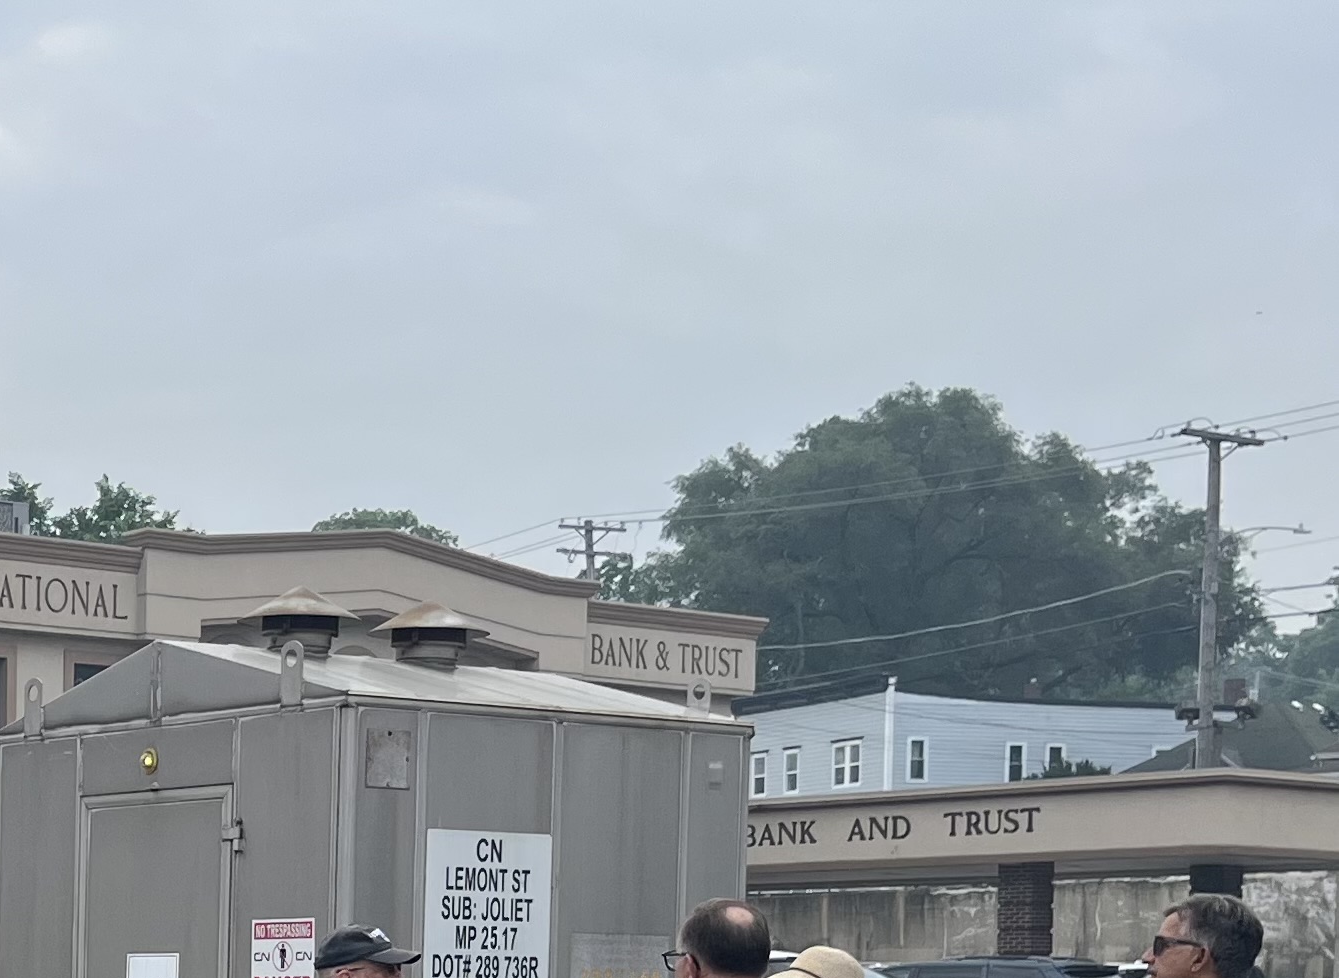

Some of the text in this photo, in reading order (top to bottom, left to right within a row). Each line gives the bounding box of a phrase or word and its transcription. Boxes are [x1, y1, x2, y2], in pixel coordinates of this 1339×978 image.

[590, 633, 743, 679] BANK & TRUST
[847, 815, 912, 842] AND
[943, 806, 1041, 838] TRUST
[476, 838, 503, 863] CN
[445, 866, 531, 893] LEMONT ST
[441, 895, 534, 922] SUB: JOLIET
[255, 922, 311, 938] NO TRESPASSING
[455, 925, 518, 951] MP 25.17
[253, 951, 312, 962] CN CN
